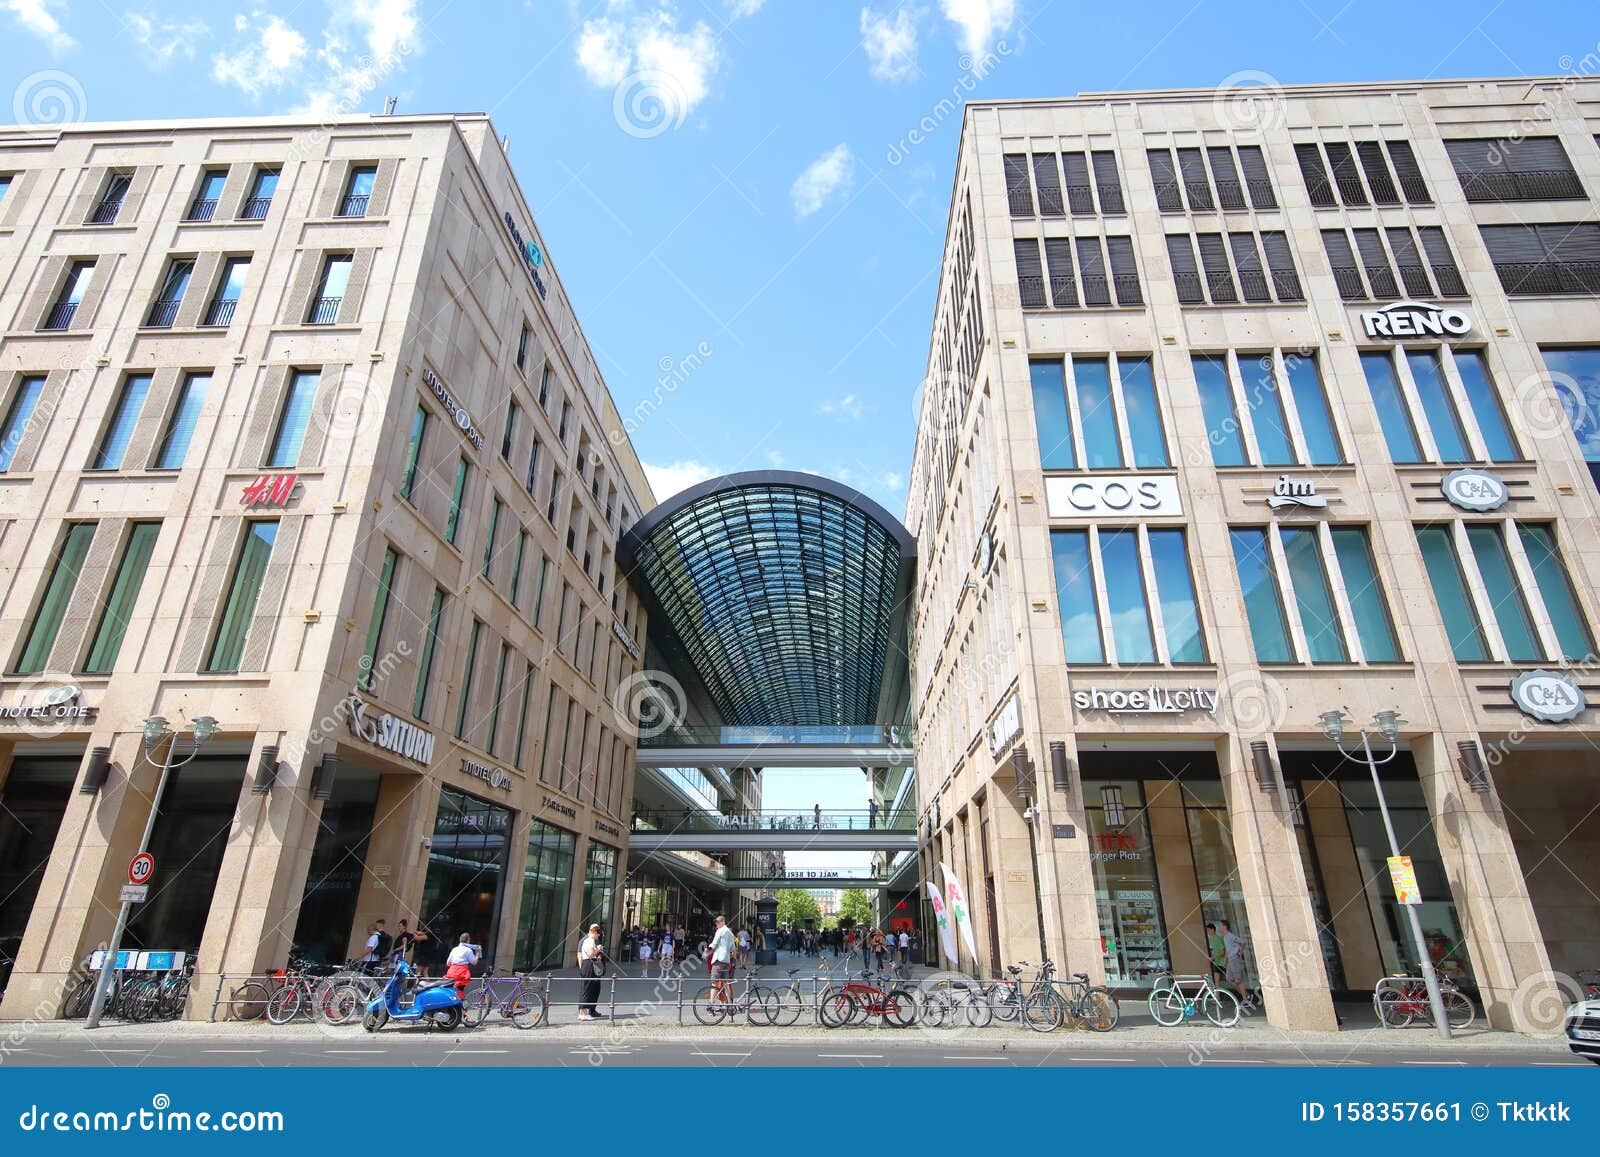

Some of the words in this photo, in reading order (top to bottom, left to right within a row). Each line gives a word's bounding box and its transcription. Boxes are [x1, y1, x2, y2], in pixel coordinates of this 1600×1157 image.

[1361, 309, 1472, 336] RENO
[239, 474, 297, 506] H&M
[1067, 482, 1161, 510] COS
[1275, 475, 1316, 496] dm
[1456, 480, 1499, 498] C&A
[1074, 686, 1146, 709] shoe
[1175, 685, 1219, 718] city
[1526, 684, 1576, 706] C&A
[378, 713, 435, 765] SATURN
[1119, 850, 1141, 860] Platz
[133, 861, 149, 876] 30
